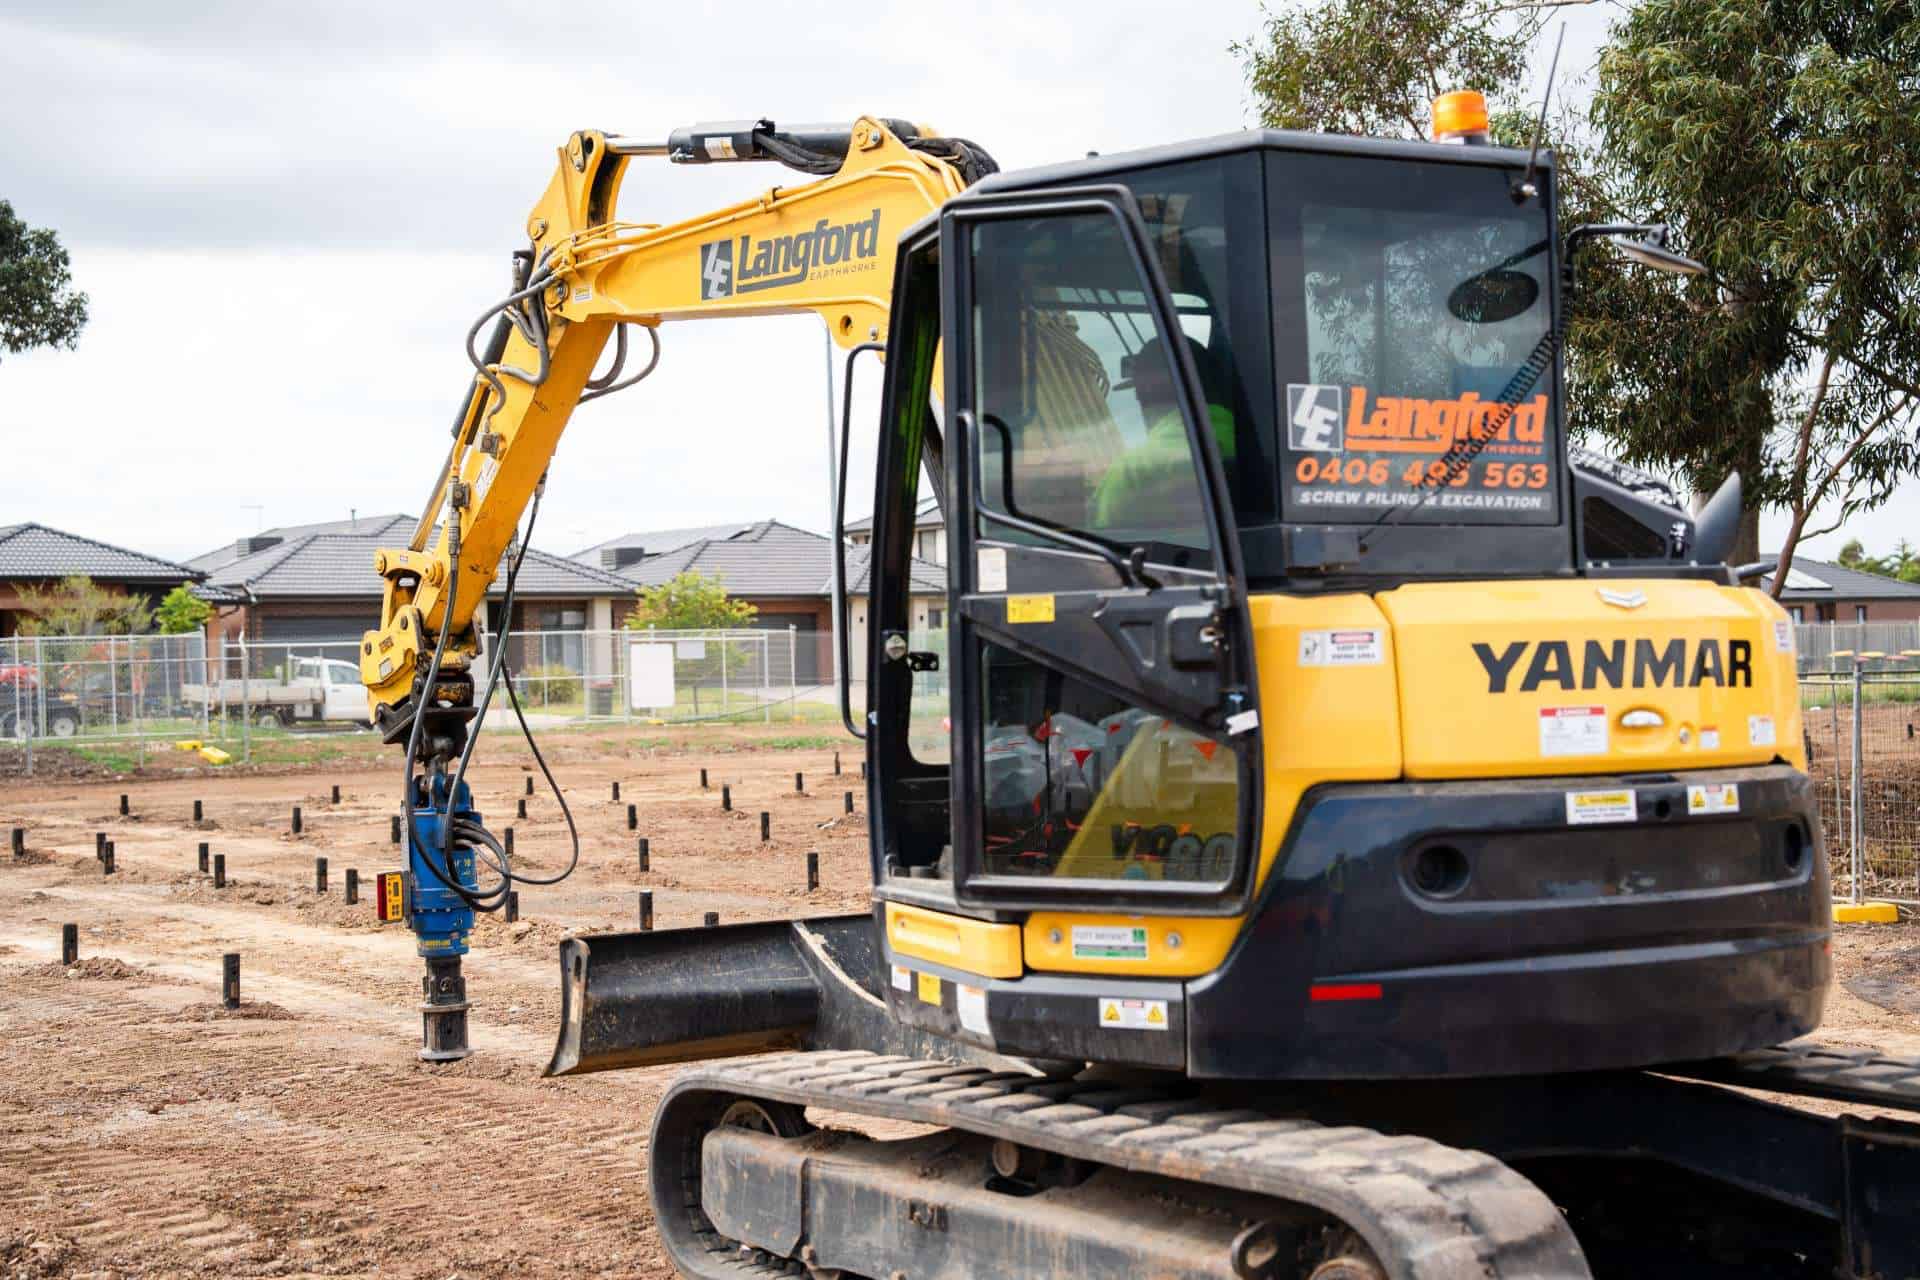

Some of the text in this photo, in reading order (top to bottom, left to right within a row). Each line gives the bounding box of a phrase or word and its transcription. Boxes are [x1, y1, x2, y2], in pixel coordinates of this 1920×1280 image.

[736, 208, 881, 294] Langford
[1344, 386, 1548, 453] Langford
[1295, 456, 1391, 486] 0406
[1482, 461, 1548, 489] 563
[1300, 491, 1360, 505] SCREW
[1365, 492, 1420, 506] PILING
[1441, 495, 1543, 509] EXCAVATION
[1471, 638, 1752, 693] YANMAR
